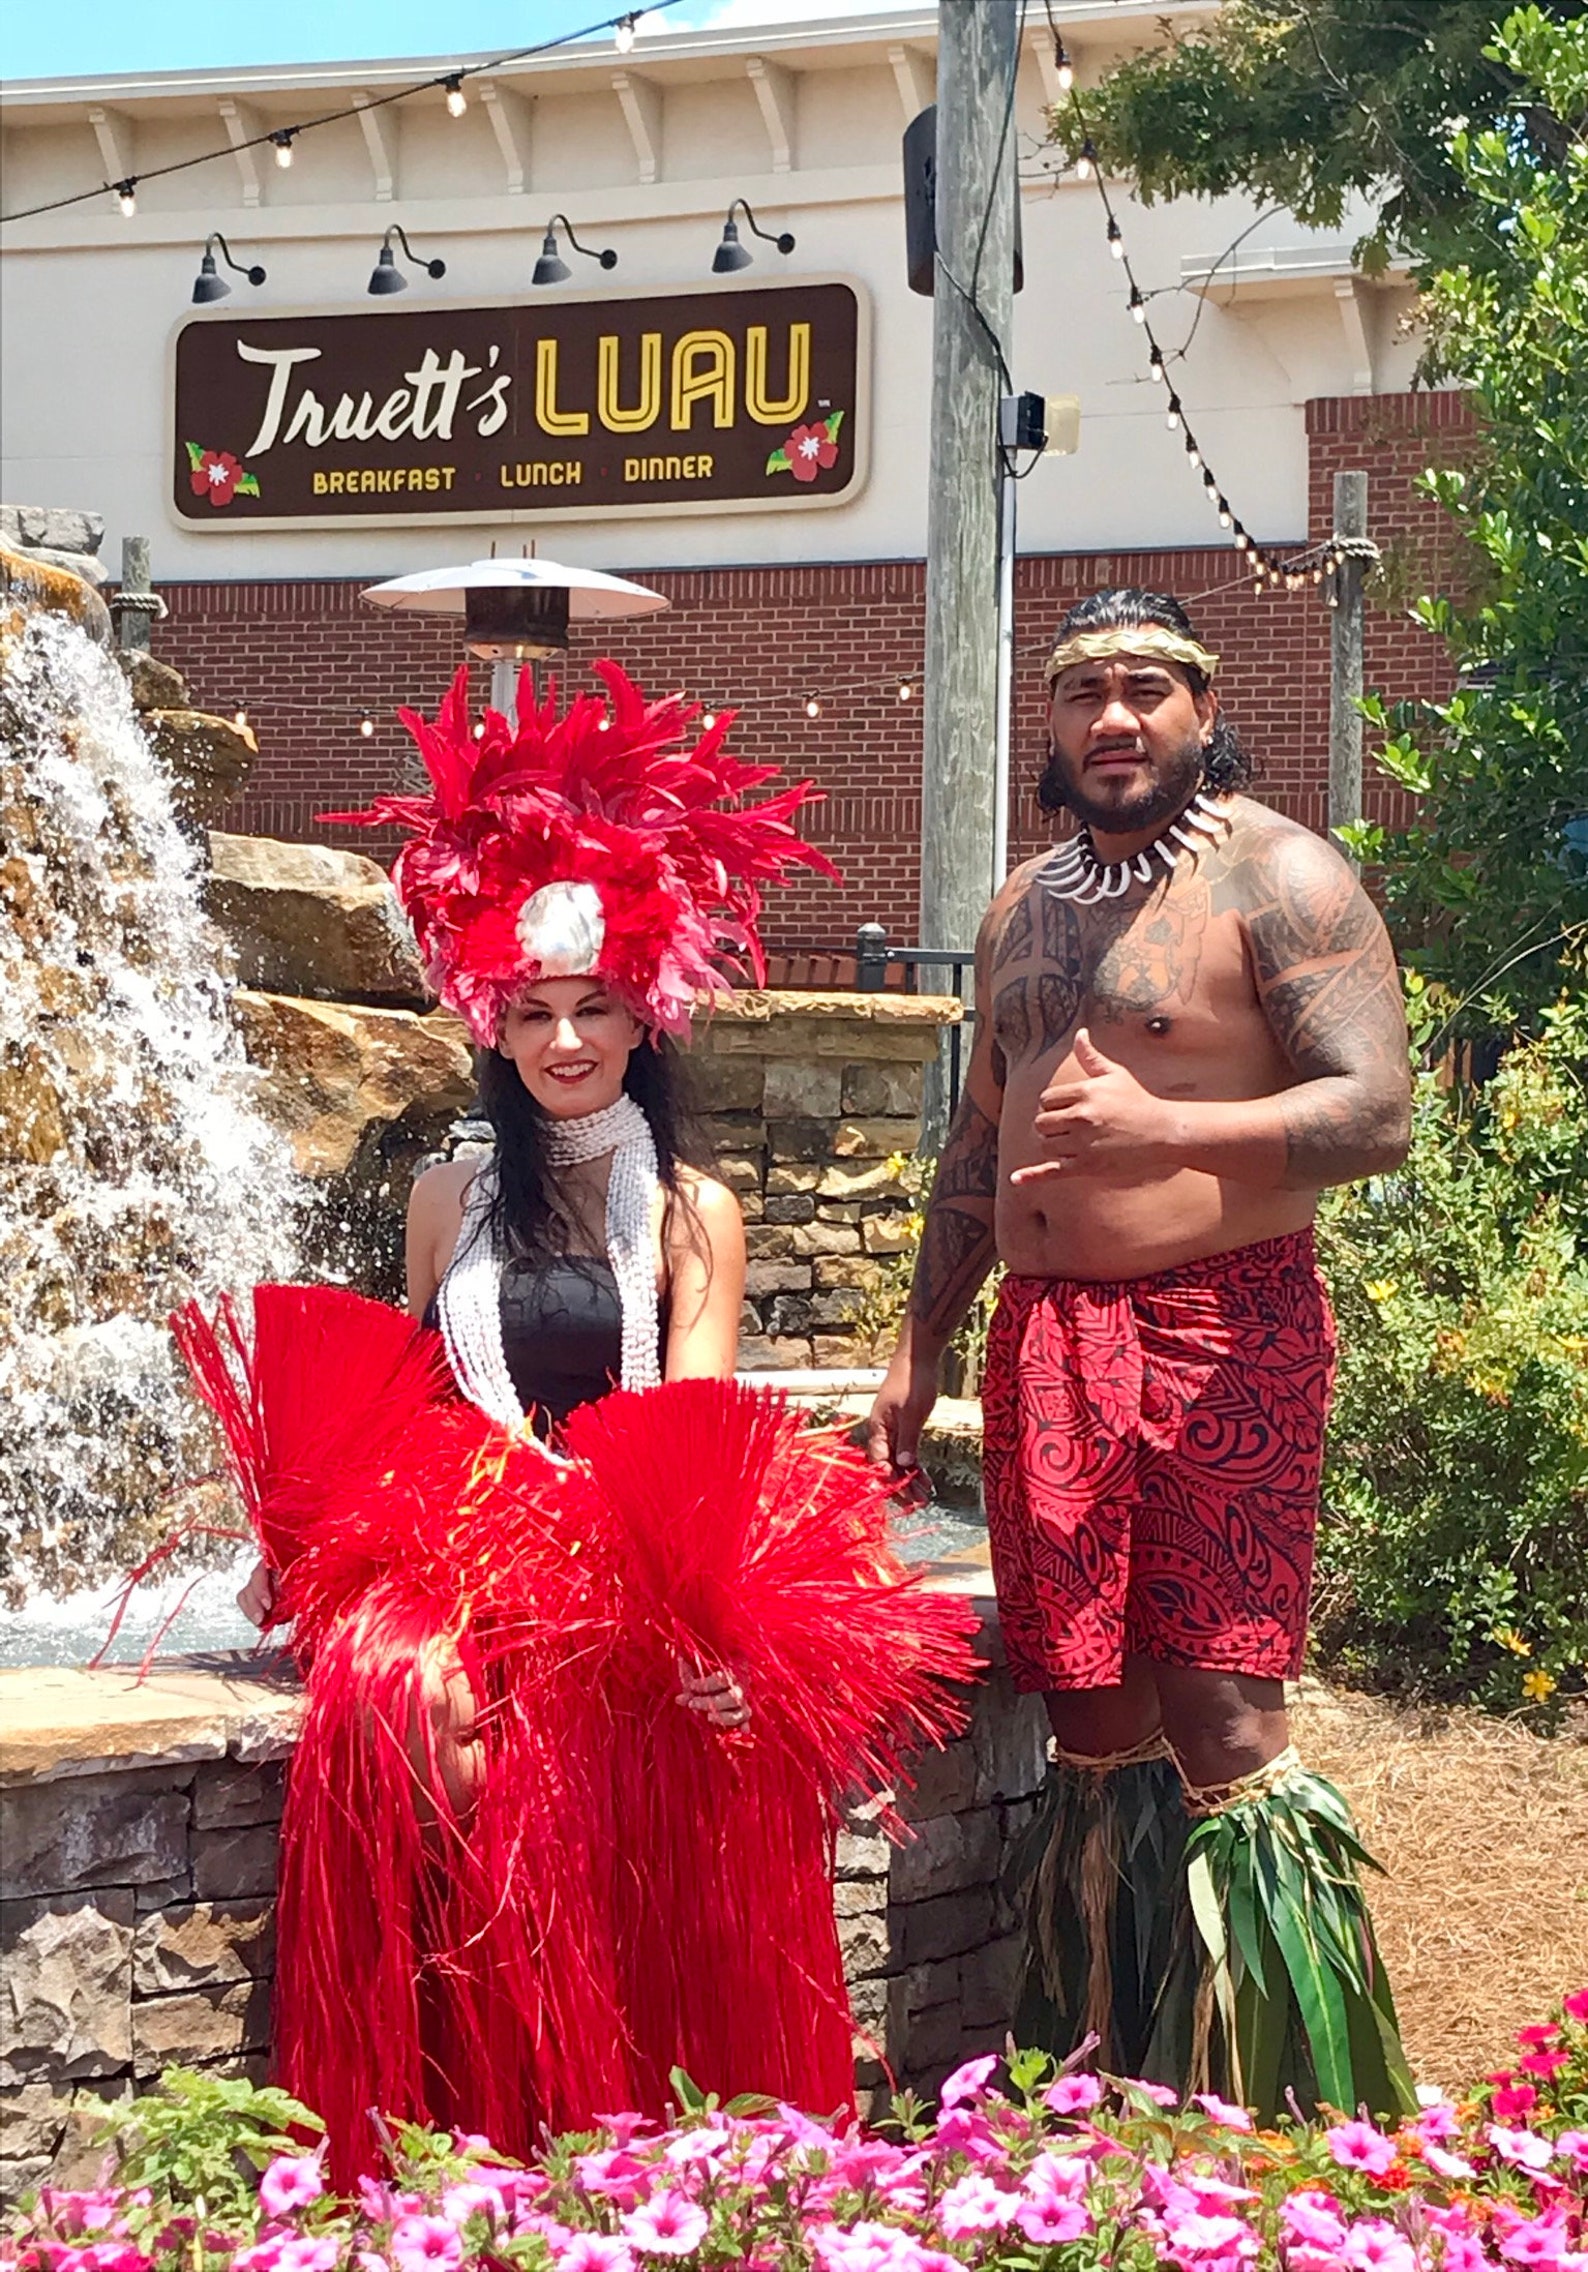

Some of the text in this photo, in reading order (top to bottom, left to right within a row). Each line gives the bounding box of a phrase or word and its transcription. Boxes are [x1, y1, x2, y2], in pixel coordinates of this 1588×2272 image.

[237, 323, 812, 457] Truett's LUAU
[313, 455, 713, 495] BREAKFAST LUNCH DINNER
